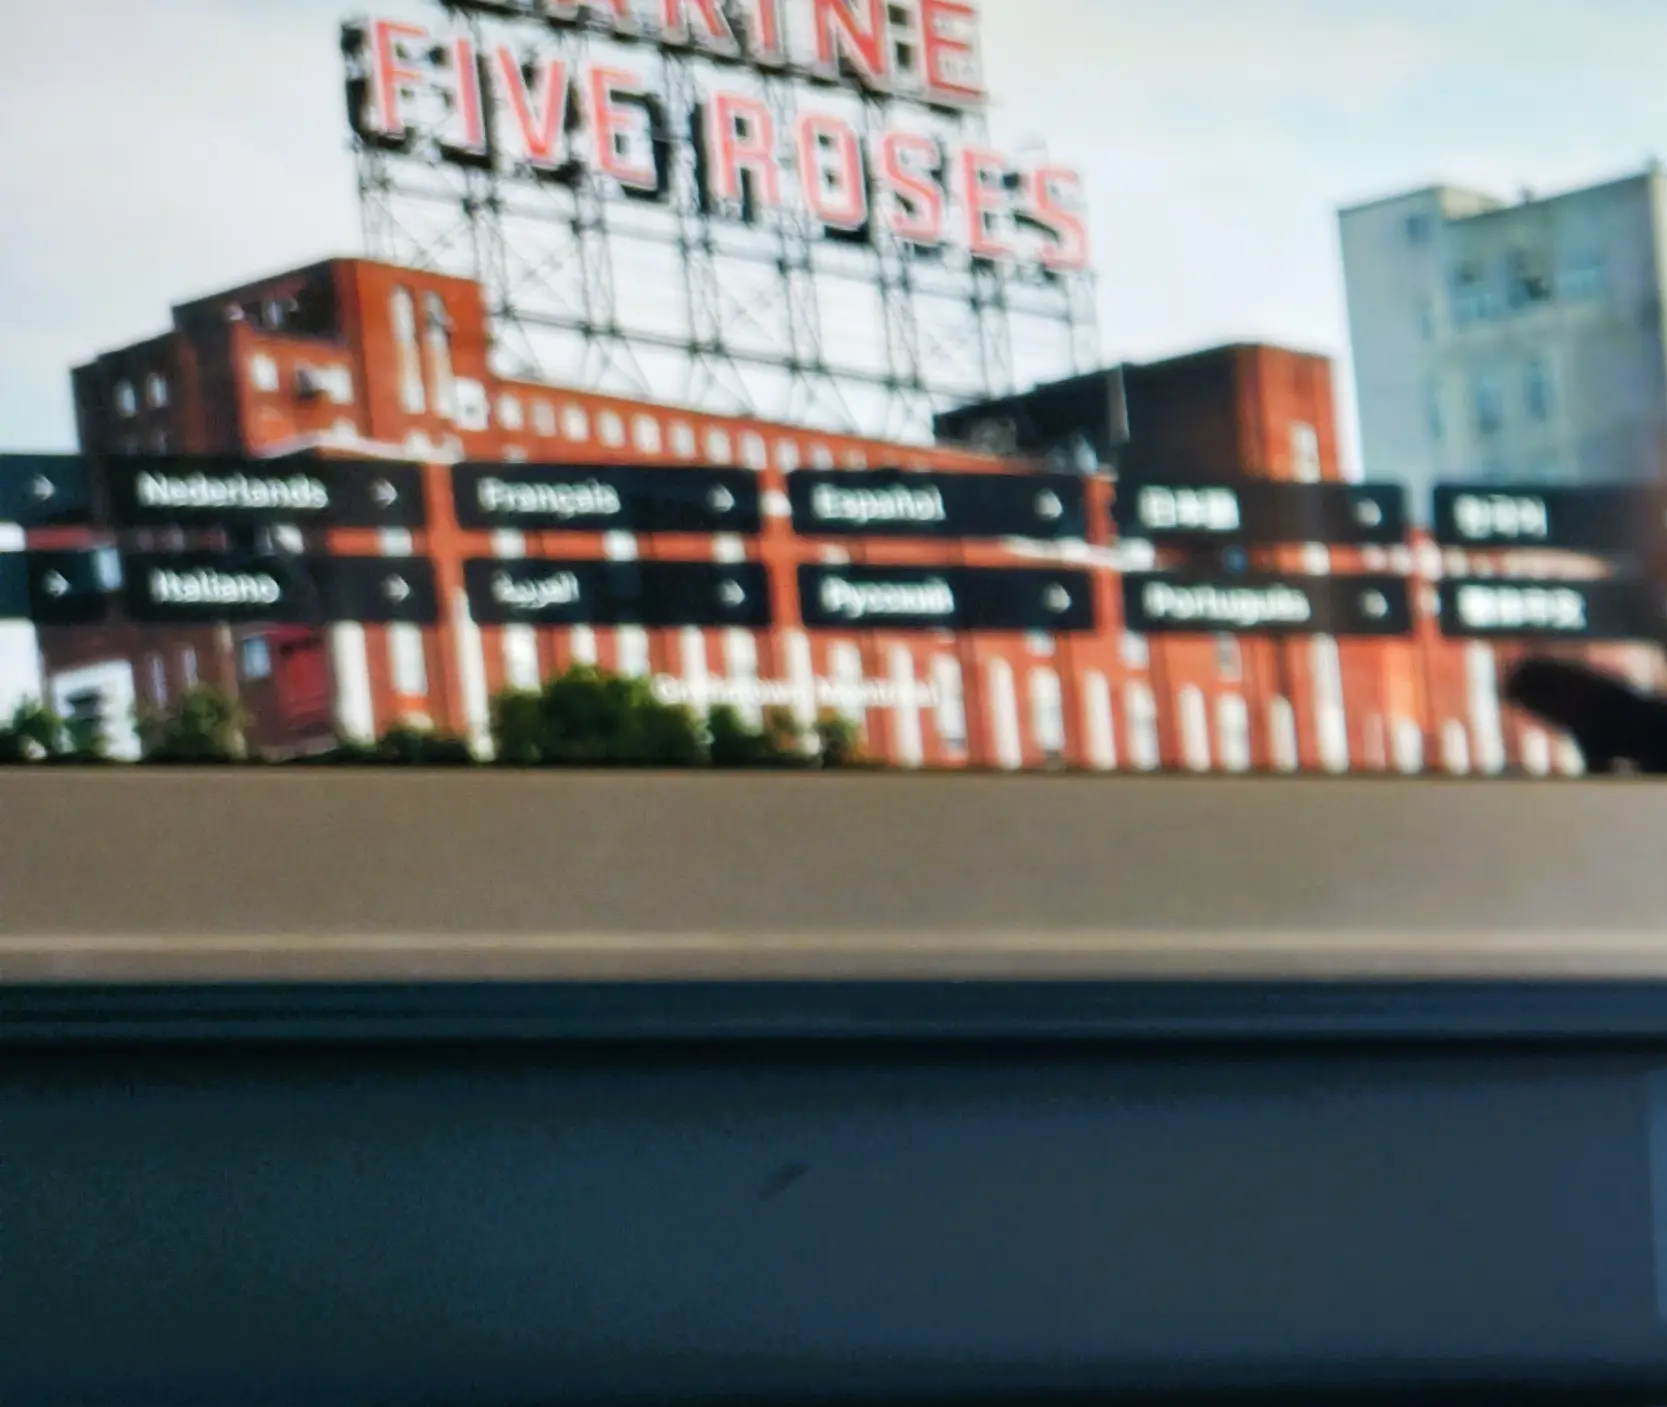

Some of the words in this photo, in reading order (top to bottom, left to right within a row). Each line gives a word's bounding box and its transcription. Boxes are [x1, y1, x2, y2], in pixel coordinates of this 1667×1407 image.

[345, 15, 662, 195] FIVE
[702, 88, 1095, 272] ROSES
[136, 470, 328, 508] Nederlands
[478, 476, 621, 518] Français
[812, 482, 946, 523] Español
[150, 567, 280, 603] Italiano
[1142, 582, 1312, 626] Português
